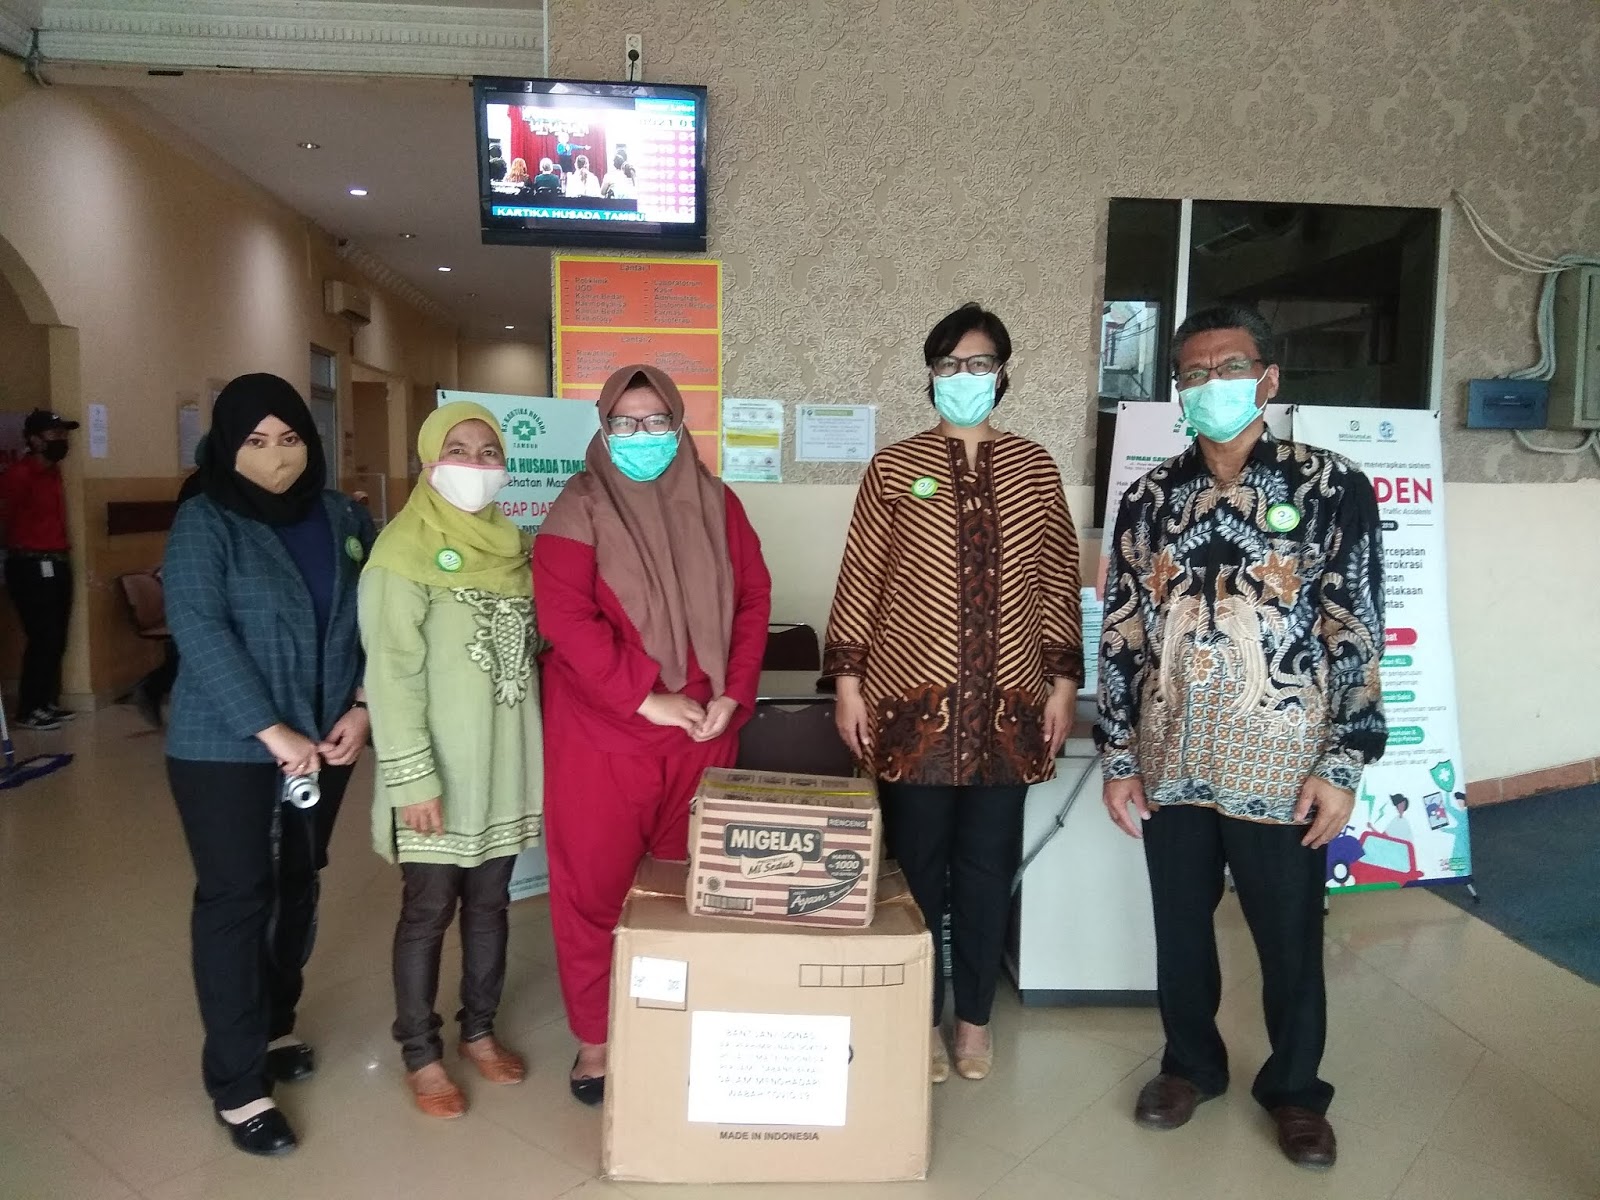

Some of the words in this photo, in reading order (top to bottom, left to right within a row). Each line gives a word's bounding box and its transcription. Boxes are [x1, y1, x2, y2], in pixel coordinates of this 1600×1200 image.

[497, 207, 549, 218] KARTIKA
[551, 209, 599, 220] HUSADA
[519, 458, 559, 474] HUSADA
[1373, 476, 1433, 505] DEN
[730, 828, 816, 853] MIGELAS
[834, 860, 860, 870] 1000
[790, 893, 828, 913] Ayam
[719, 1131, 749, 1140] MADE
[751, 1131, 762, 1140] IN
[764, 1131, 819, 1142] INDONESIA
